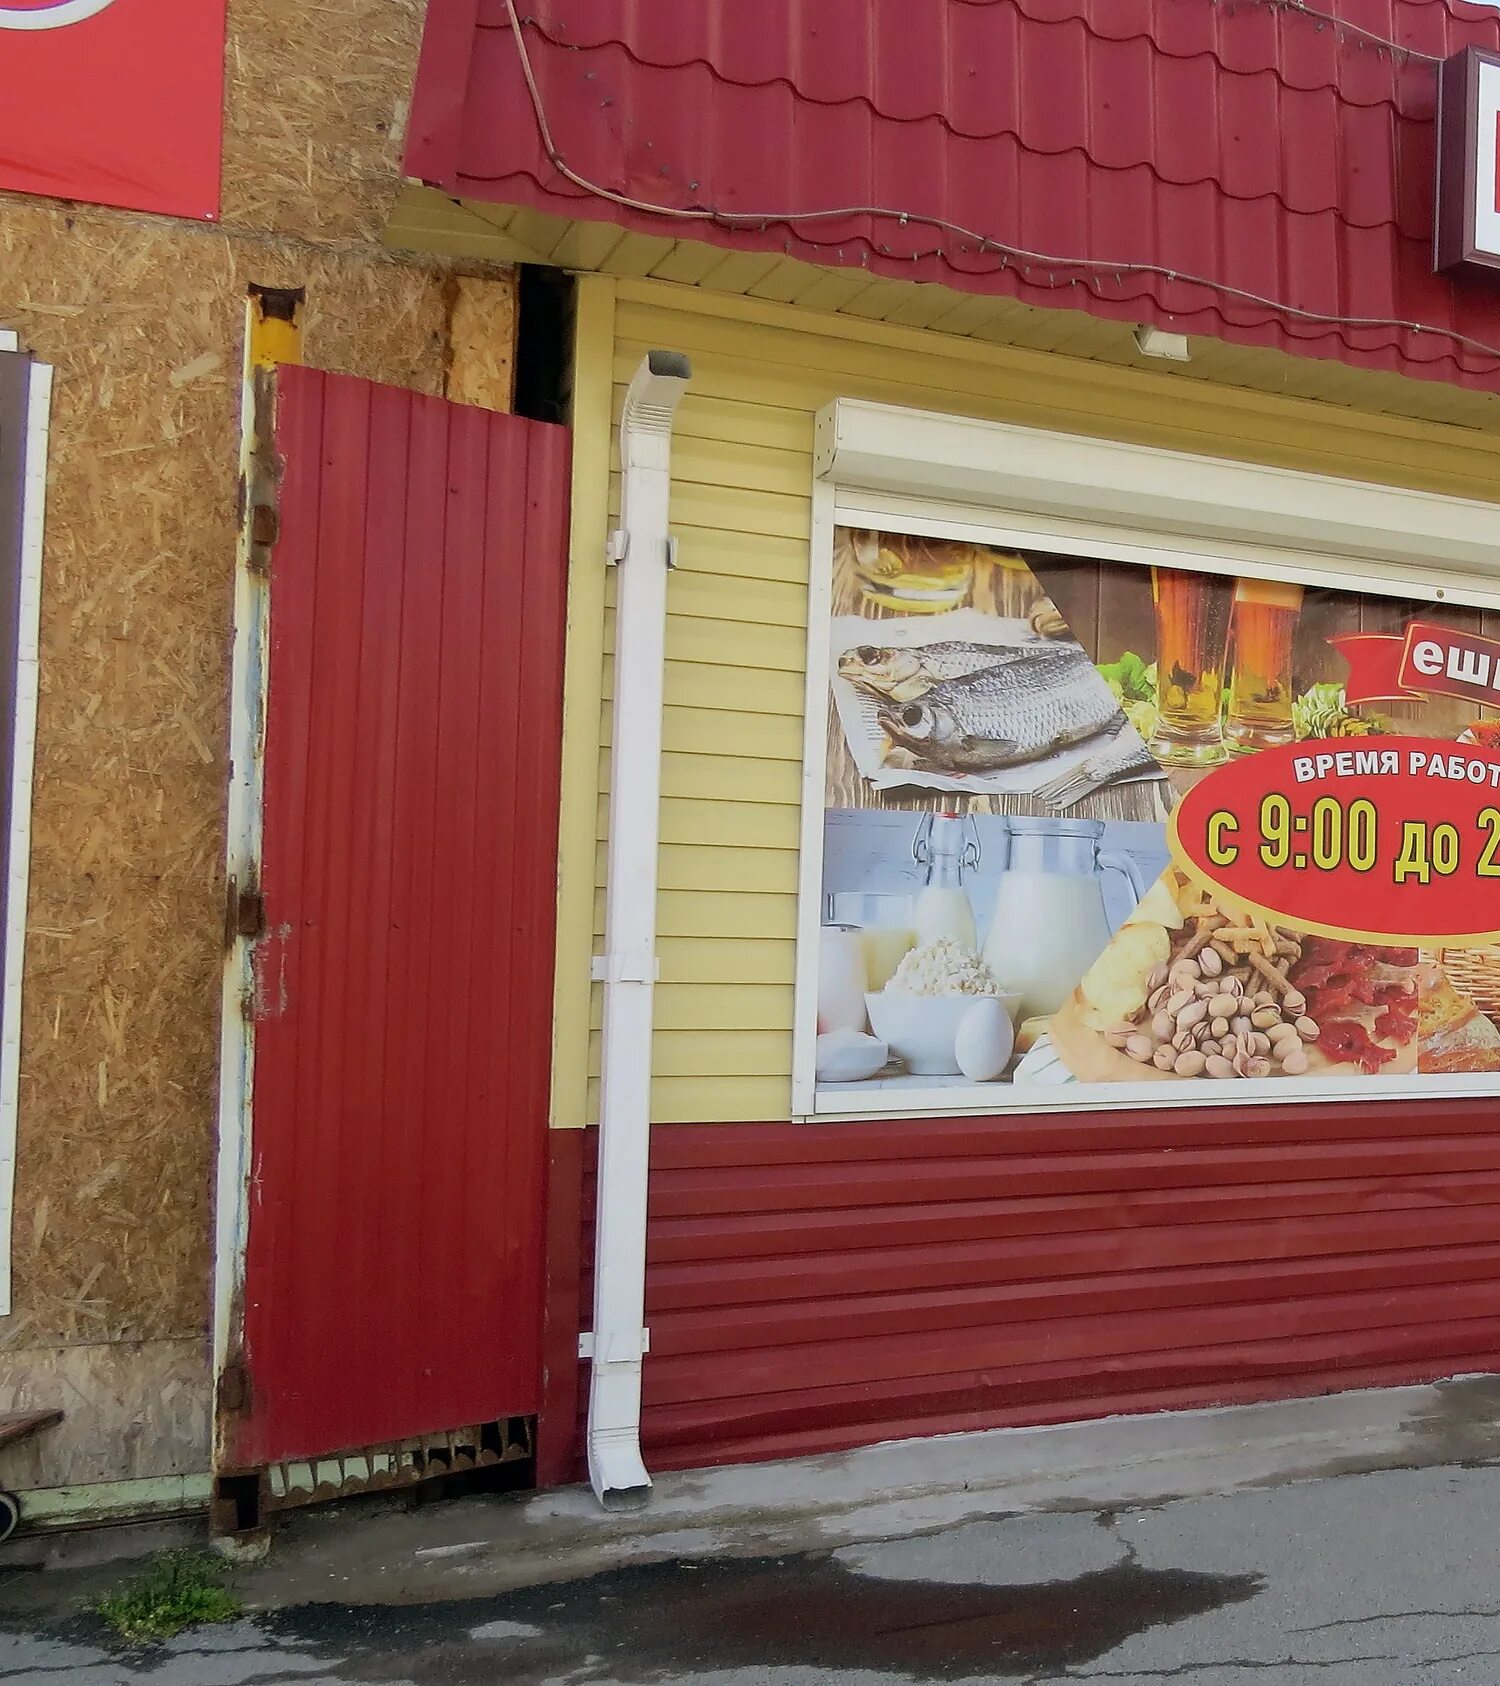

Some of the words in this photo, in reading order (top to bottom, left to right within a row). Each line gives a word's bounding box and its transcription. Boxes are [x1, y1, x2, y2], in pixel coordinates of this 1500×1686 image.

[1293, 750, 1400, 784] ВРЕМЯ
[1258, 793, 1378, 872] 9:00
[1393, 820, 1461, 885] до
